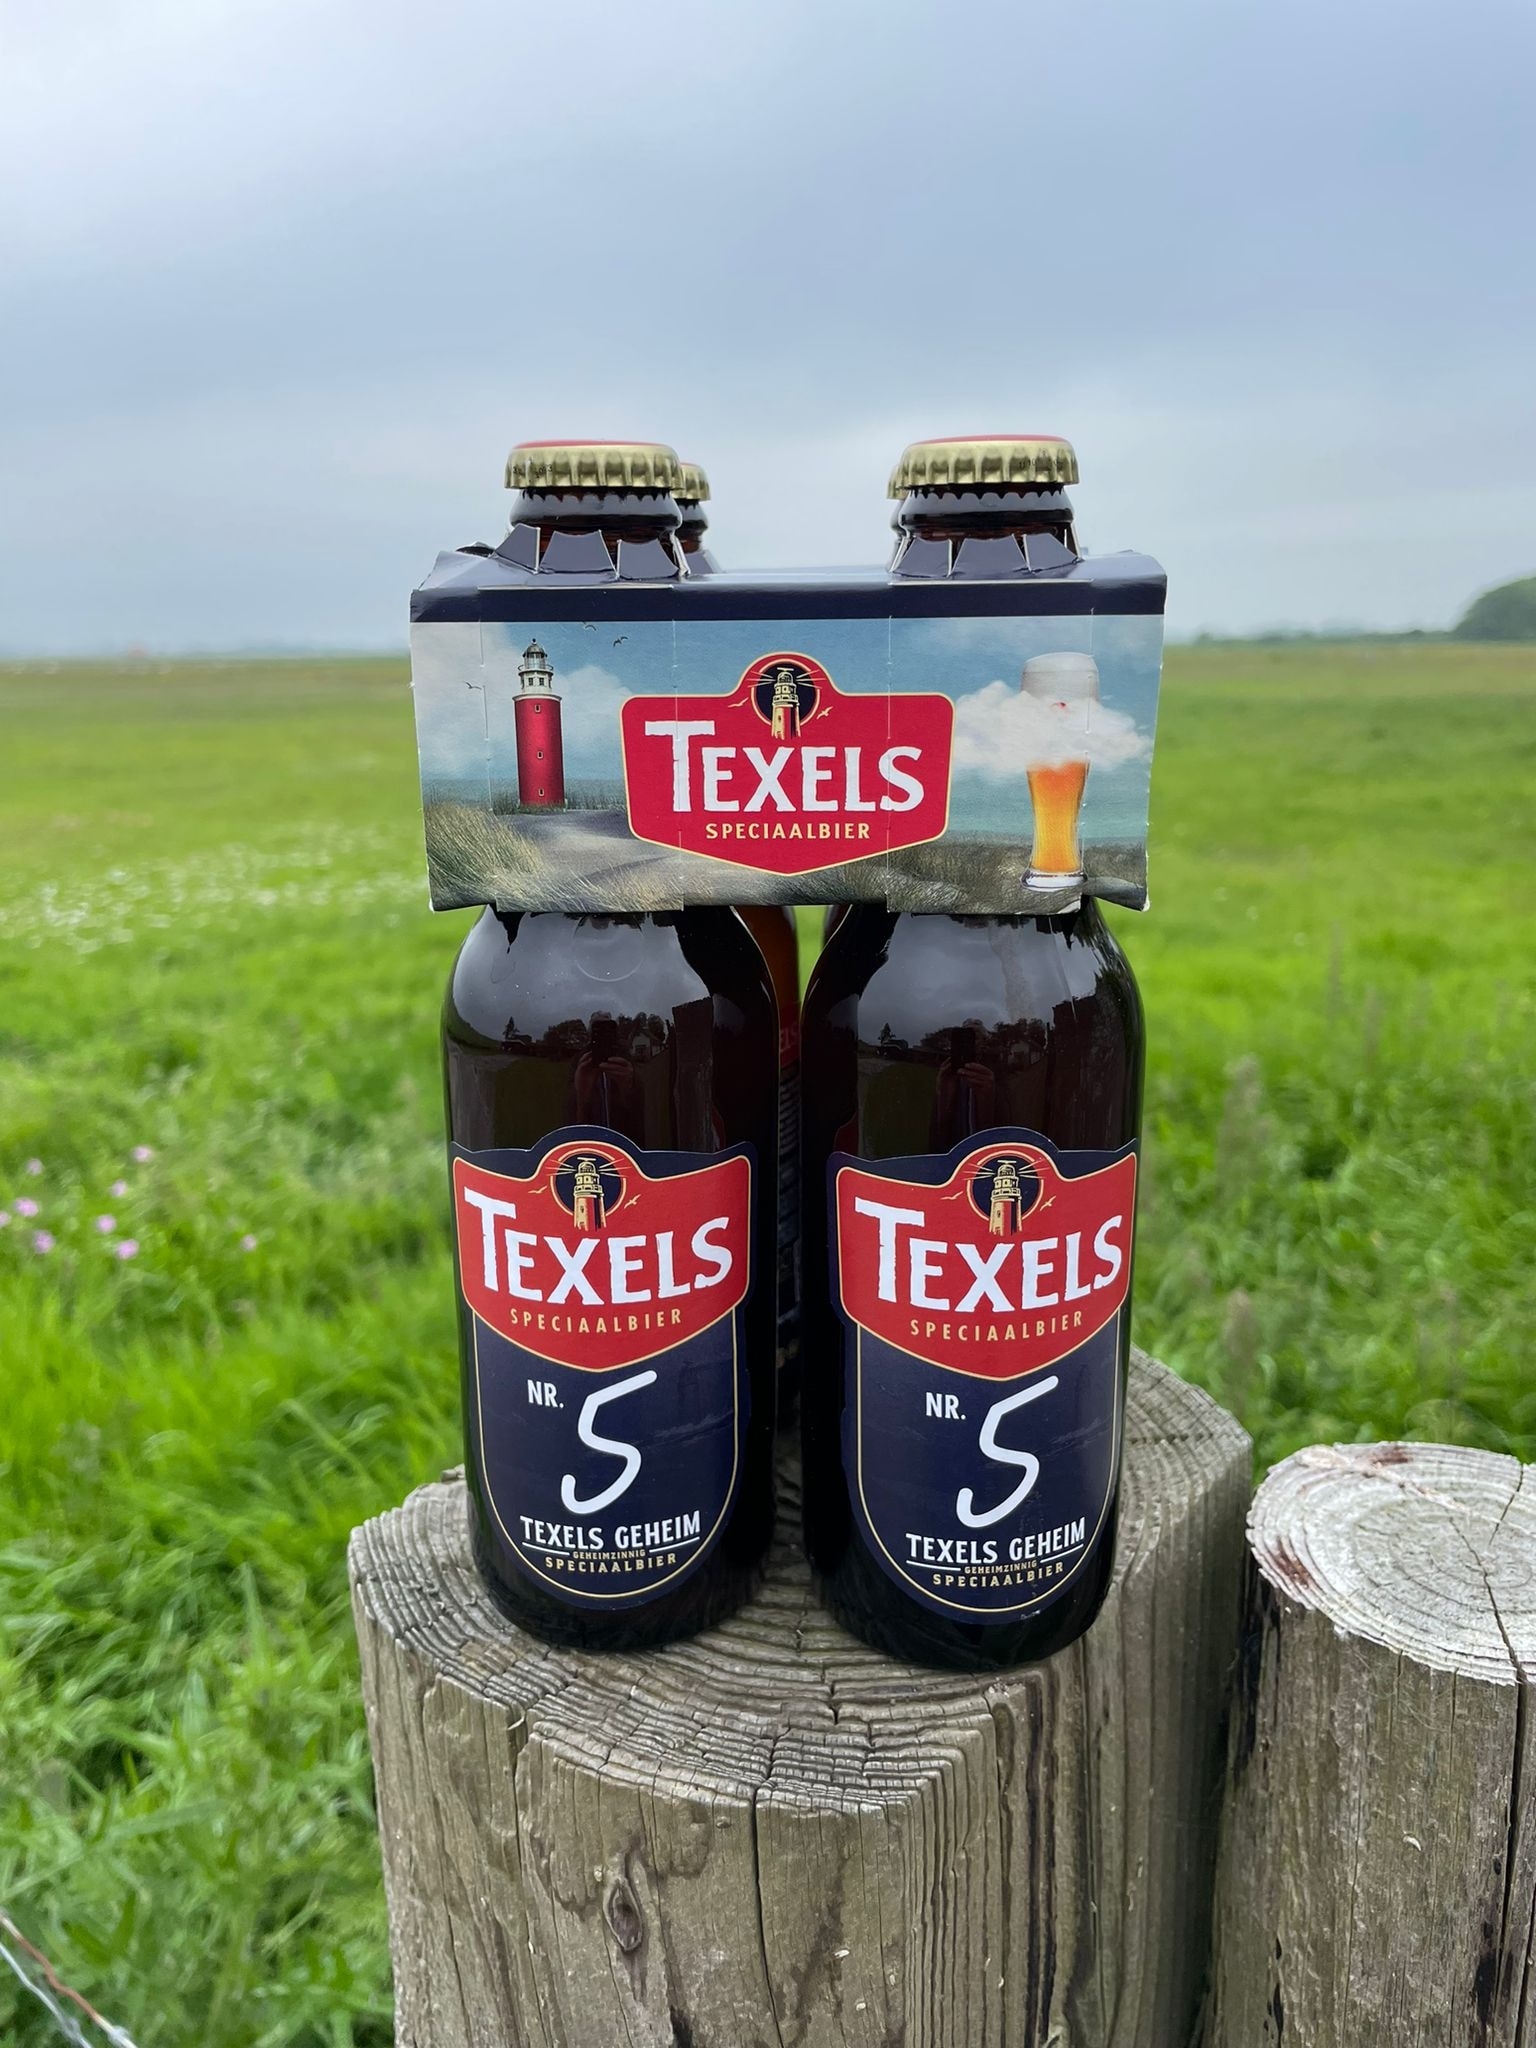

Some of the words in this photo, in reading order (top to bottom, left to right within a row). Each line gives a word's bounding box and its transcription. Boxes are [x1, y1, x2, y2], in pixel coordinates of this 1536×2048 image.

[644, 720, 924, 813] TEXELS
[706, 823, 871, 840] SPECIAALBIER
[464, 1186, 733, 1305] TEXELS
[855, 1196, 1122, 1313] TEXELS
[510, 1308, 682, 1333] SPECIAALBIER
[910, 1311, 1083, 1341] SPECIAALBIER
[527, 1379, 564, 1409] NR.
[561, 1370, 657, 1514] 5
[925, 1392, 966, 1420] NR.
[956, 1375, 1059, 1528] 5
[520, 1515, 604, 1550] TEXELS
[614, 1510, 700, 1549] GEHEIM
[905, 1533, 998, 1564] TEXELS
[1008, 1517, 1085, 1561] GEHEIM
[545, 1553, 677, 1573] SPECIAALBIER
[573, 1549, 646, 1560] GEHEIMZINNIG
[964, 1560, 1037, 1574] GEHEIMZINNIG
[932, 1562, 1064, 1588] SPECIAALBIER
